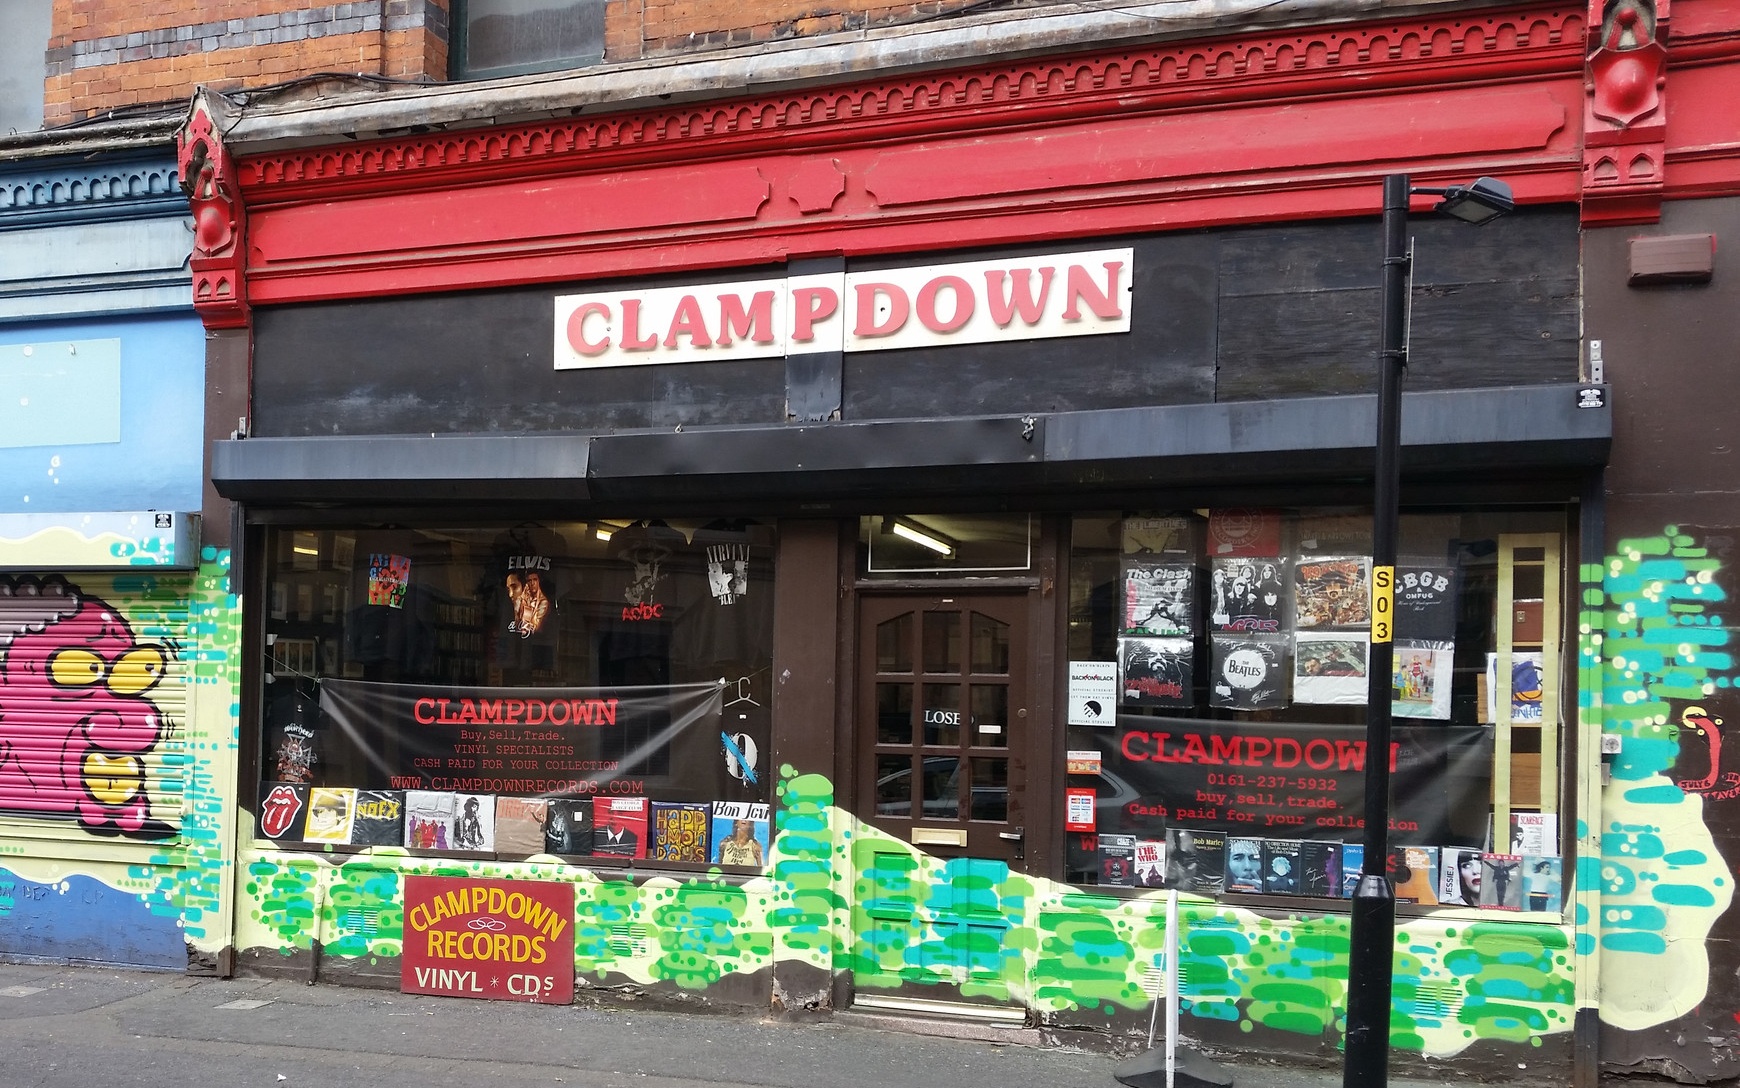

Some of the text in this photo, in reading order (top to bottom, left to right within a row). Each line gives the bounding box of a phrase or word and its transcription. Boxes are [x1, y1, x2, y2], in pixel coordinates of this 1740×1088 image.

[566, 261, 1125, 355] CLAMPDOWN
[507, 555, 551, 571] ELVIS
[1126, 568, 1192, 579] The Clash
[621, 600, 664, 621] AC/DC
[1228, 659, 1262, 677] BEATLES
[414, 697, 619, 726] CLAMPDOWN
[924, 710, 974, 725] LOSE
[460, 730, 566, 742] Buy,Sell,Trade.
[454, 744, 574, 756] VINYL SPECIALISTS
[414, 758, 619, 771] CASH PAID FOR YOUR COLLECTION
[390, 776, 644, 794] WWW.CLAMPDOWNRECORDS.COM
[1208, 773, 1338, 791] 0161-237-5932
[1681, 780, 1703, 788] JULY
[1196, 789, 1345, 810] buy,sell,trade.
[356, 800, 400, 821] NOFX
[713, 801, 770, 820] Bon Jovi
[1128, 803, 1418, 831] Cash paid for your colleion
[1520, 815, 1544, 825] SCARFACE
[1138, 846, 1155, 856] THE
[1205, 839, 1224, 847] Marley
[1137, 854, 1158, 862] WHO
[1445, 871, 1454, 897] JESSIE
[409, 887, 568, 942] CLAMPDOWN
[427, 930, 547, 964] RECORDS
[414, 966, 484, 993] VINYL
